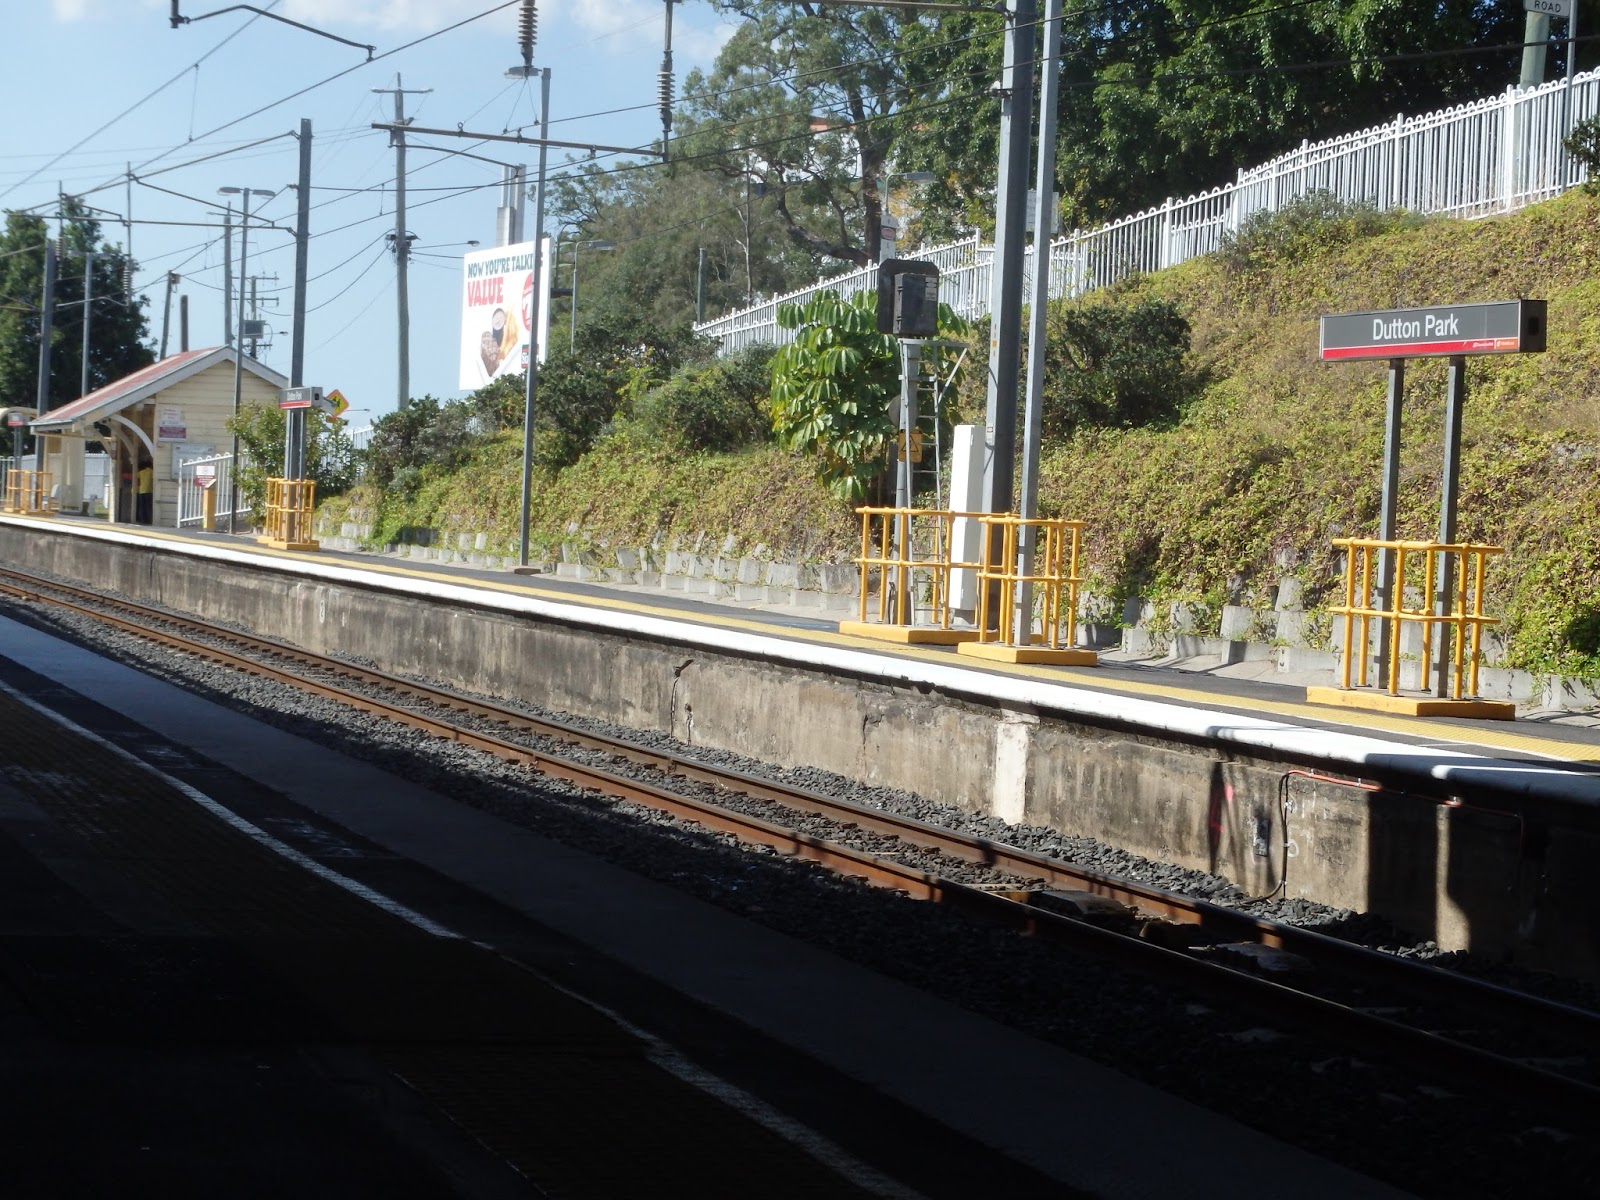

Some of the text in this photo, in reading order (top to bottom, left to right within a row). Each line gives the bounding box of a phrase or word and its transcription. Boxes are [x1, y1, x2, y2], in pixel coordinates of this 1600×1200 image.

[1534, 0, 1562, 13] ROAD
[467, 262, 483, 279] NOW
[485, 257, 510, 276] YOU'RE
[467, 276, 504, 307] VALUE
[1373, 313, 1459, 341] Dutton Park
